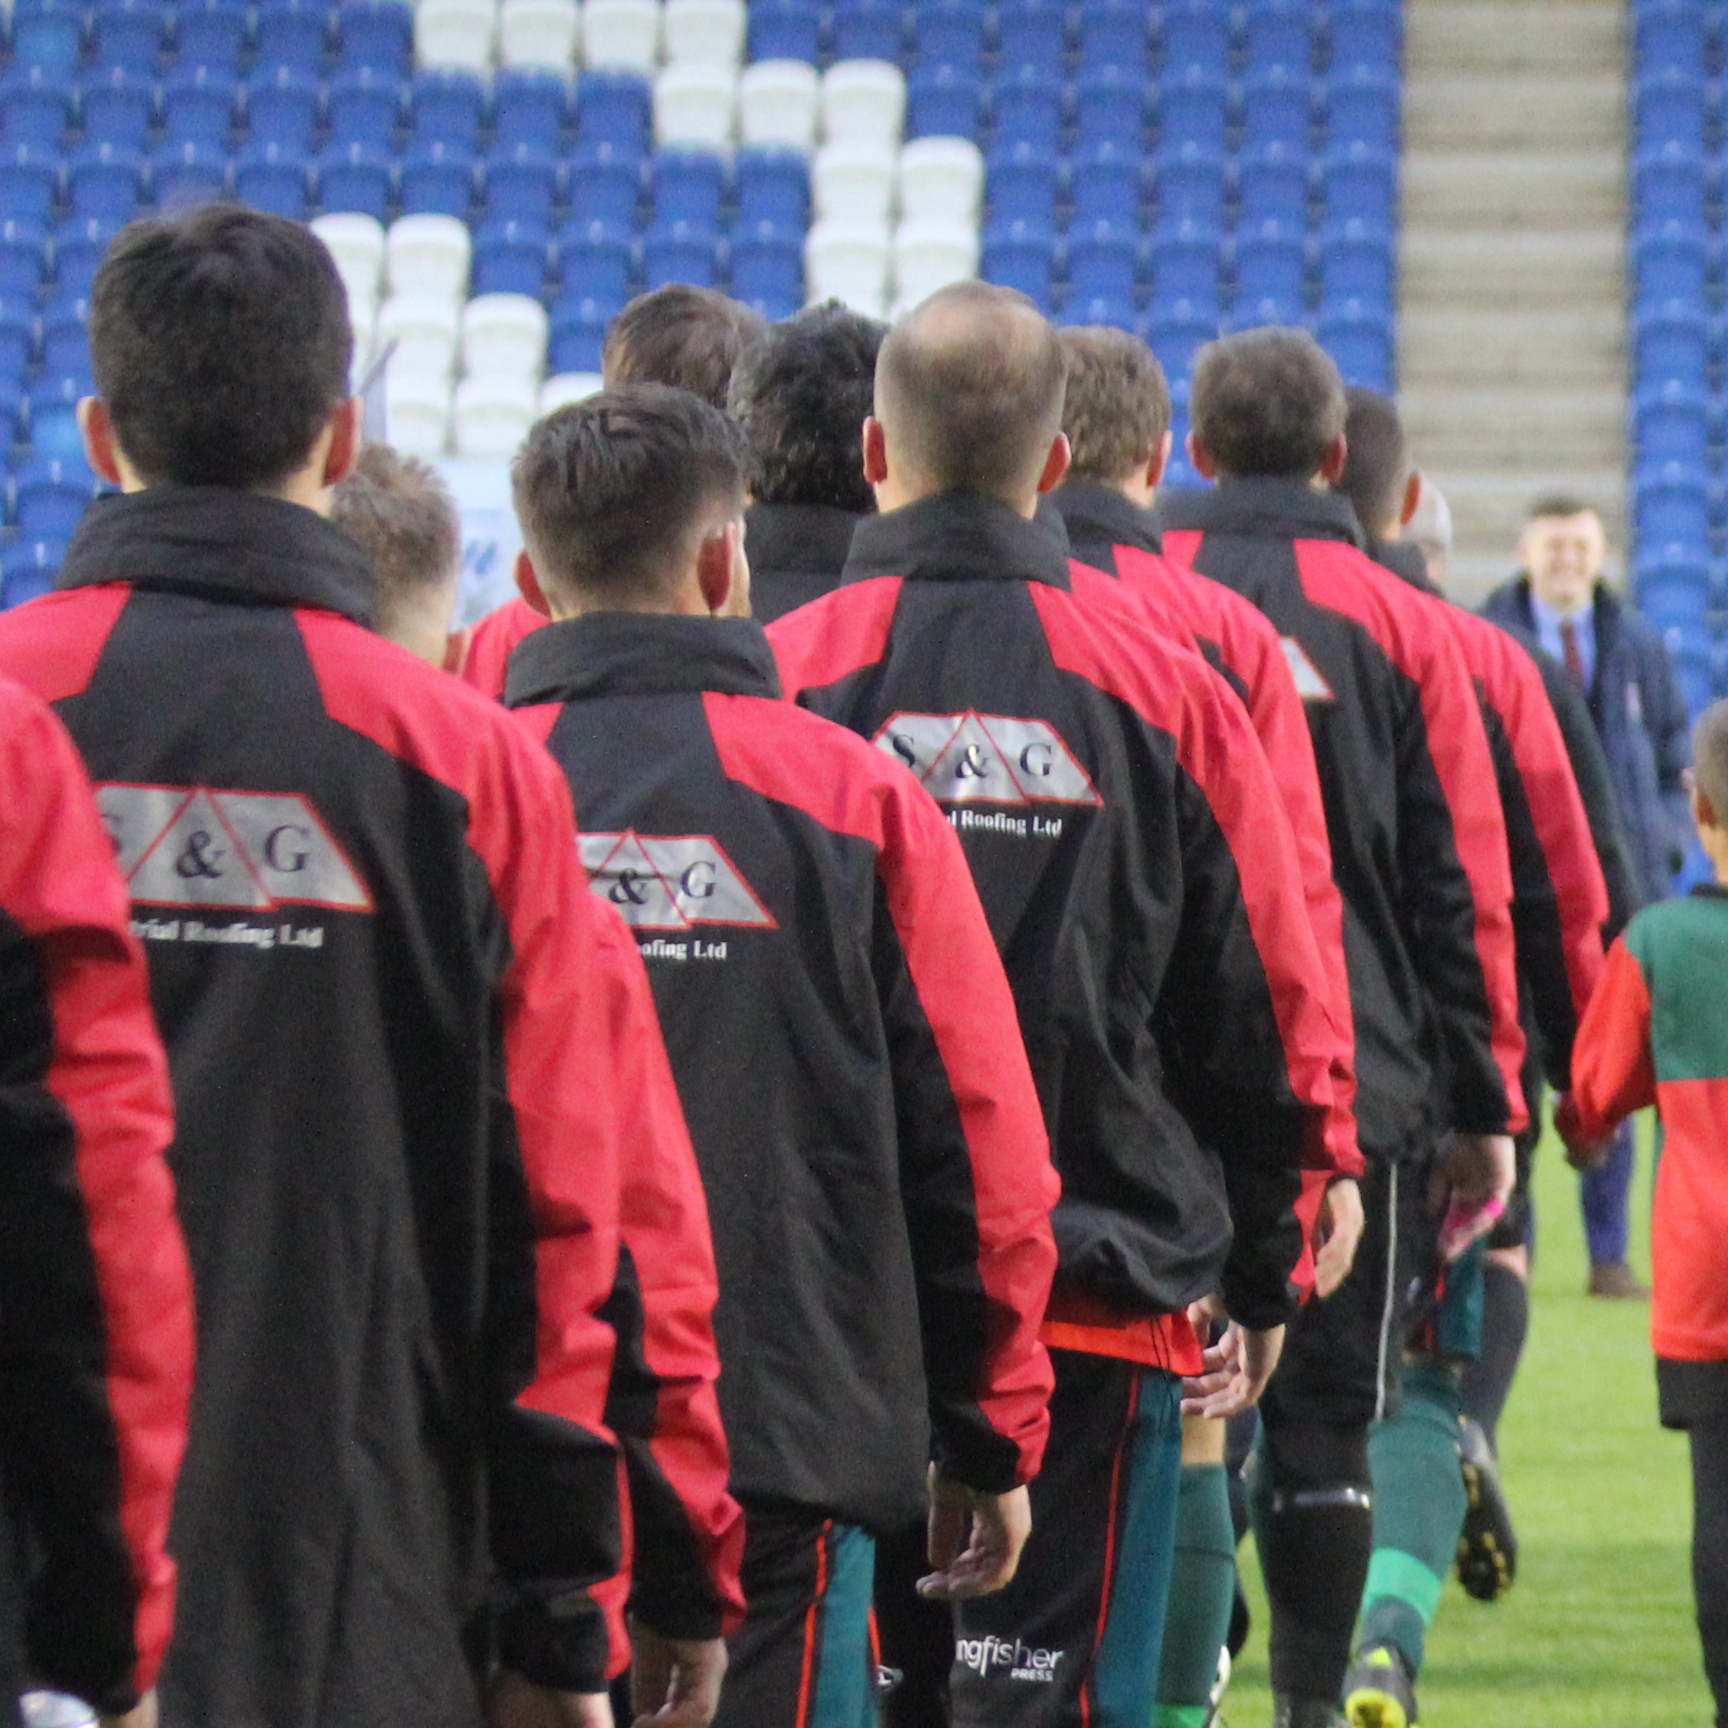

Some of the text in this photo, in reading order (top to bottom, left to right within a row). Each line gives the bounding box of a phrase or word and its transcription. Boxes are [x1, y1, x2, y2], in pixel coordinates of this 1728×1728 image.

[892, 735, 1052, 779] S & G
[961, 809, 1027, 834] Roofing
[1032, 815, 1063, 836] Ltd
[174, 830, 224, 878] &
[264, 825, 311, 873] G
[608, 860, 718, 905] & G
[639, 938, 728, 960] ofing Ltd
[955, 1635, 1065, 1678] ngfisher
[1011, 1667, 1054, 1682] PRESS
